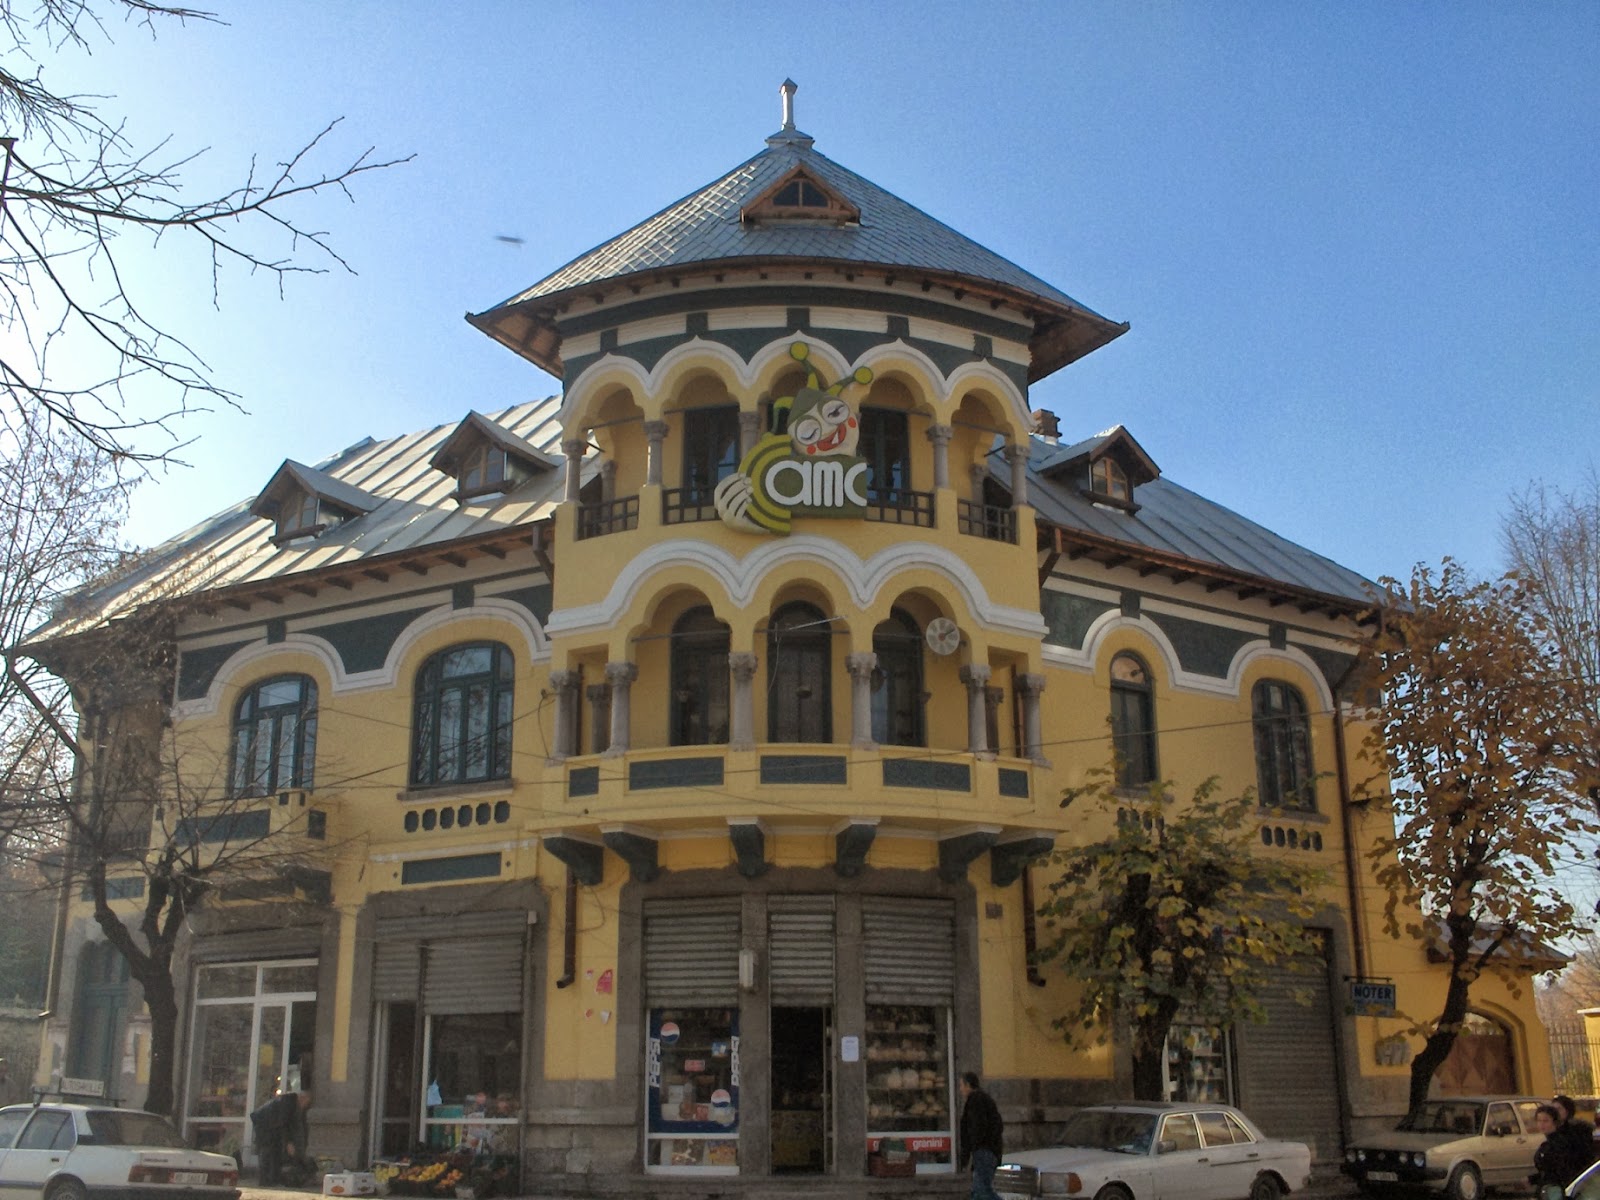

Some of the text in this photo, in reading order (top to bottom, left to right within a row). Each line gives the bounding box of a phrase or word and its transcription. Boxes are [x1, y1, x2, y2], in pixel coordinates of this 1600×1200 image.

[765, 460, 867, 507] amc
[1354, 986, 1392, 999] NOTER
[650, 1037, 661, 1088] PEPSI
[912, 1138, 943, 1151] granini
